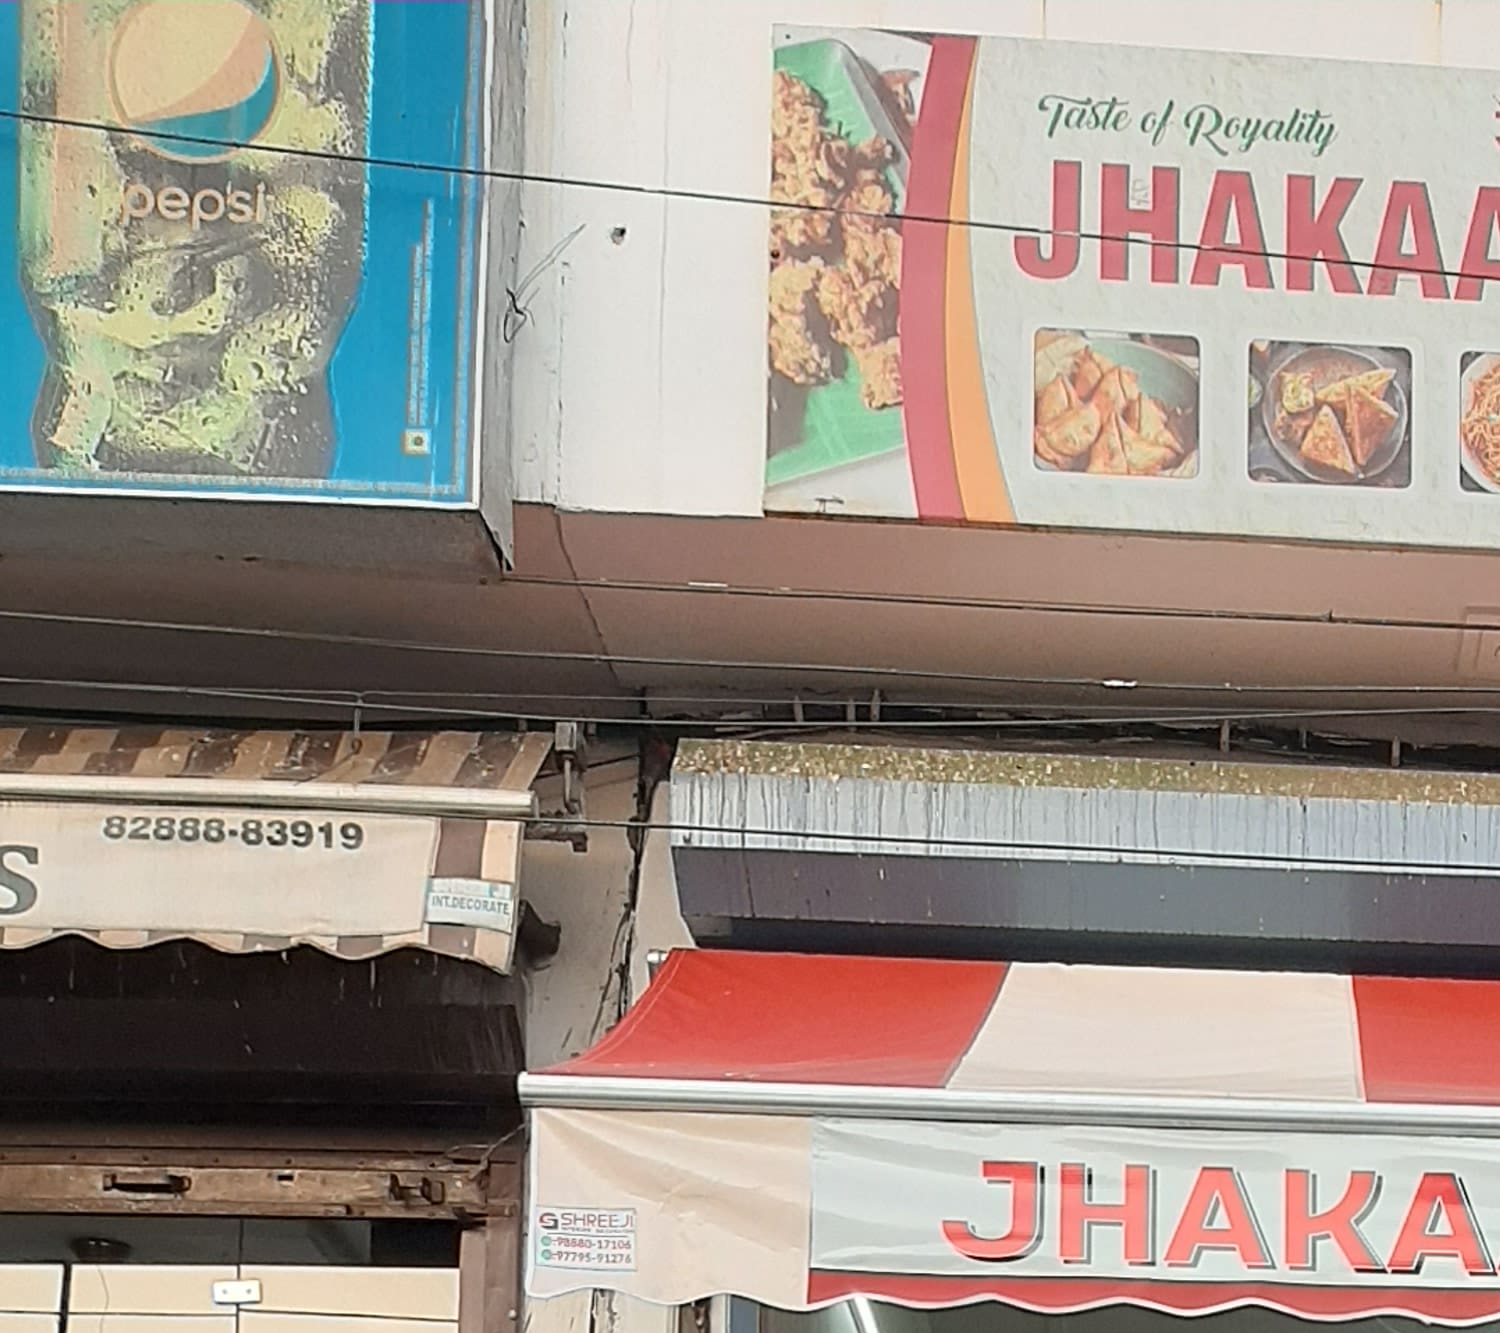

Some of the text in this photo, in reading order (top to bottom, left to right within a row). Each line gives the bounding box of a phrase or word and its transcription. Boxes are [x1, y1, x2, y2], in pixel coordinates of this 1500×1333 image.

[1038, 94, 1338, 157] Taste of Royality
[120, 181, 266, 230] pepsi
[103, 815, 365, 850] 82888-83919
